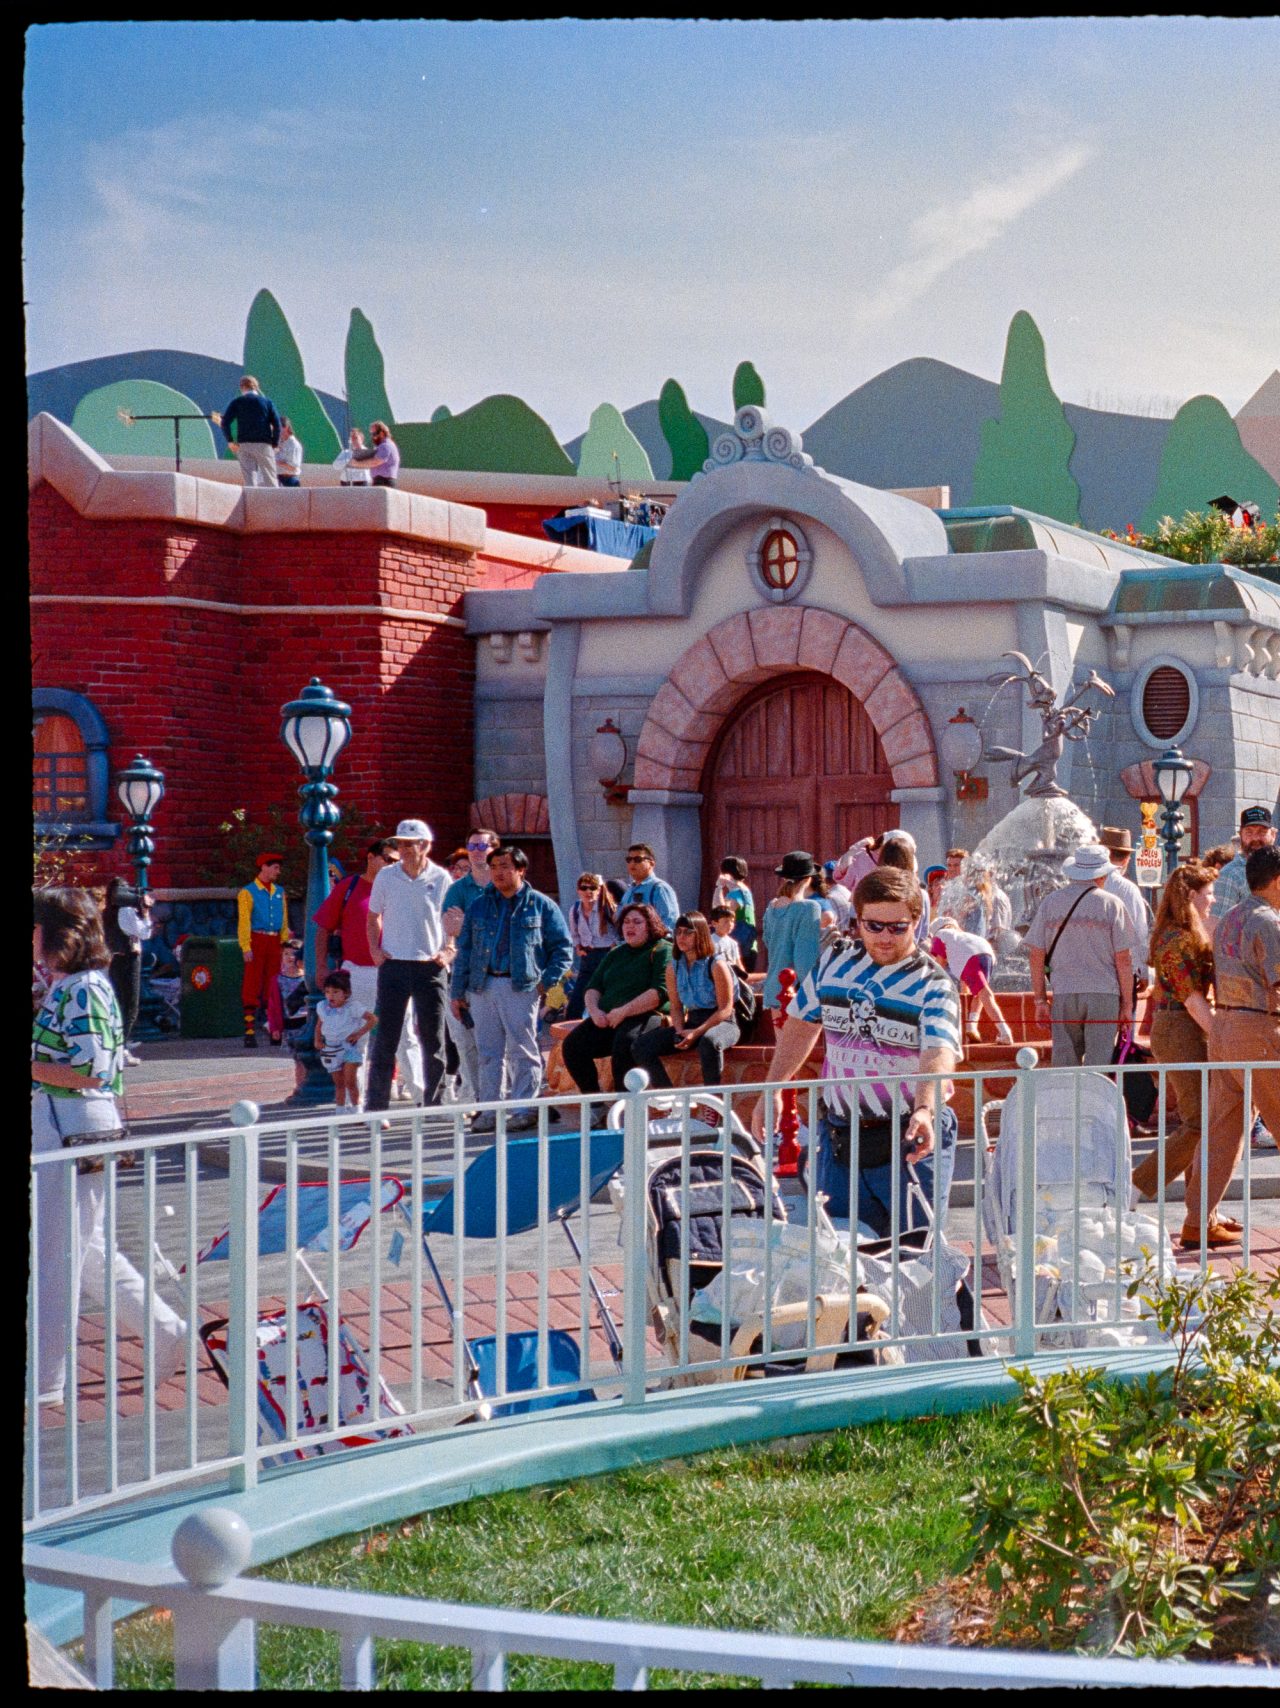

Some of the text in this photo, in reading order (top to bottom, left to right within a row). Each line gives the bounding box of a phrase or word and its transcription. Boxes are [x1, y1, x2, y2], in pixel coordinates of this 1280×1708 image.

[1141, 849, 1158, 858] JOLLY
[1136, 859, 1162, 867] TROLLEY
[873, 1022, 915, 1043] MGM
